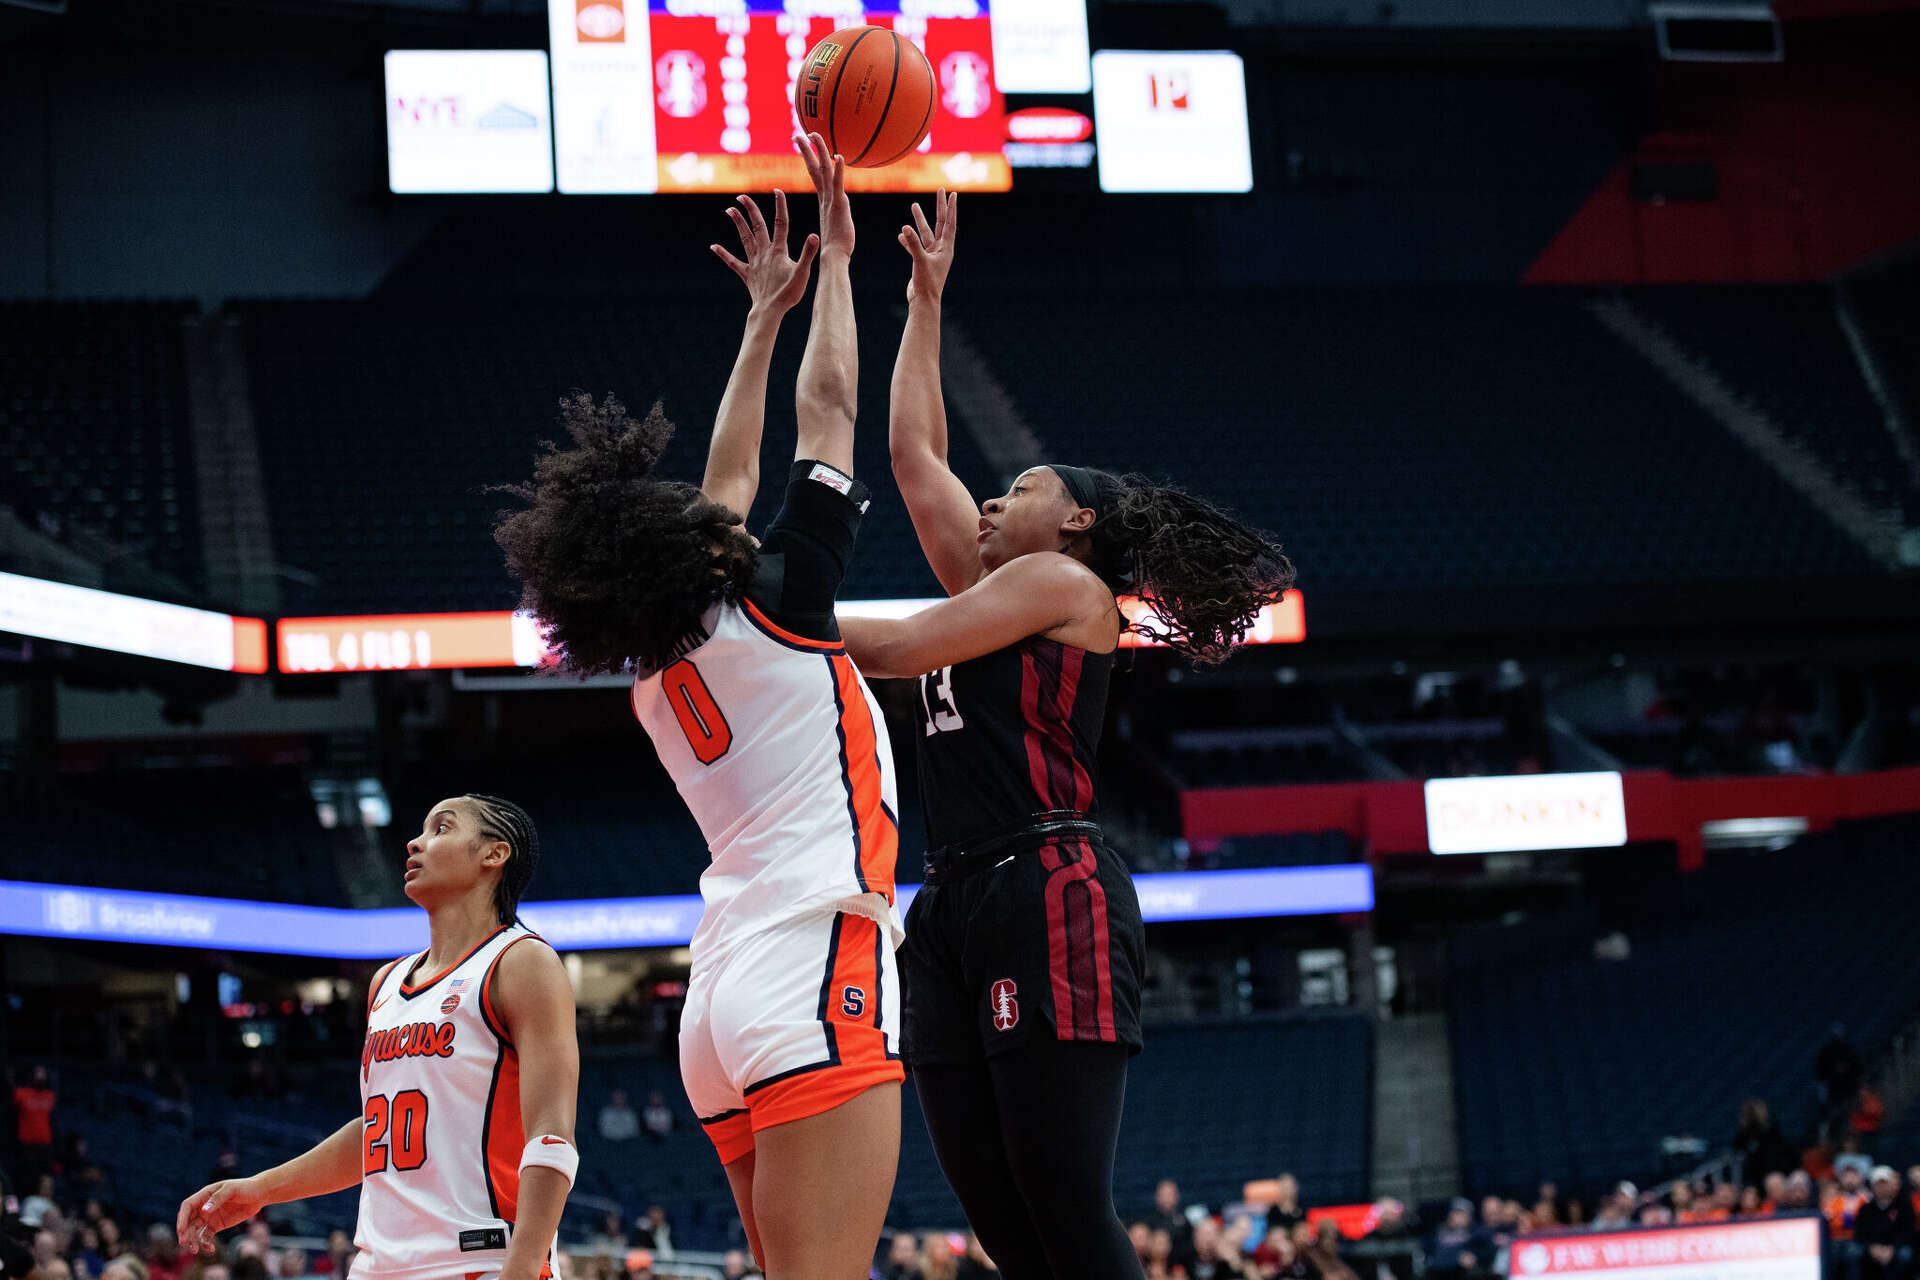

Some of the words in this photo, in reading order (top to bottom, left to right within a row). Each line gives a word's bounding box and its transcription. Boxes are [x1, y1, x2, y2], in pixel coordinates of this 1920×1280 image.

[804, 42, 838, 119] ELITE
[338, 631, 359, 670] 4
[414, 629, 433, 668] 1
[661, 657, 733, 766] 0
[919, 665, 964, 737] 13
[842, 985, 865, 1017] S
[364, 1088, 429, 1177] 20
